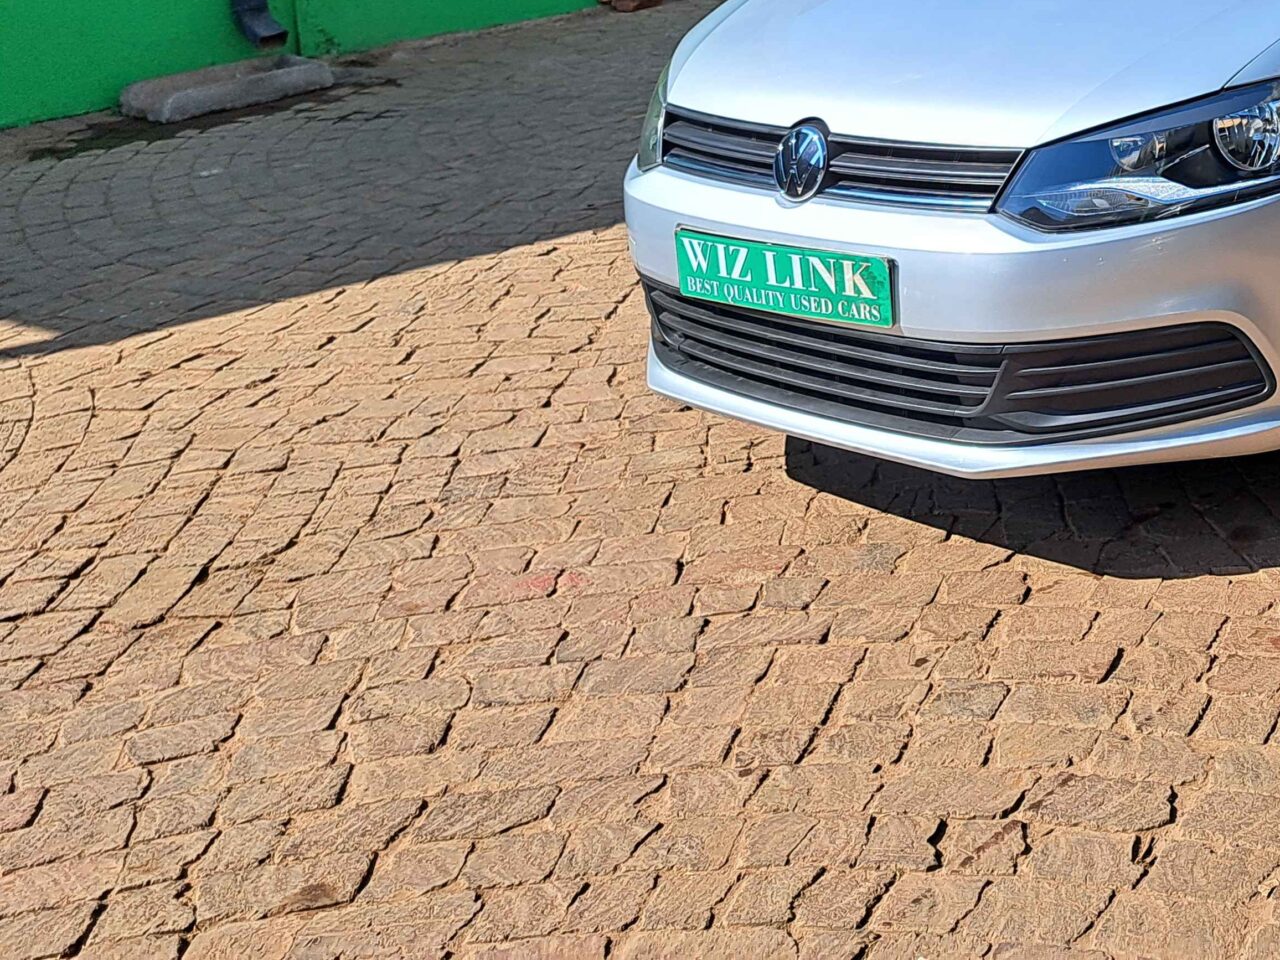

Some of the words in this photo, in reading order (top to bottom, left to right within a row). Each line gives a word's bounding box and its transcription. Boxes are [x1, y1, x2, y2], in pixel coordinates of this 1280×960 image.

[680, 236, 752, 282] WIZ
[762, 250, 877, 300] LINK
[687, 275, 719, 296] BEST
[724, 283, 785, 308] QUALITY
[790, 294, 832, 315] USED
[837, 300, 881, 322] CARS
